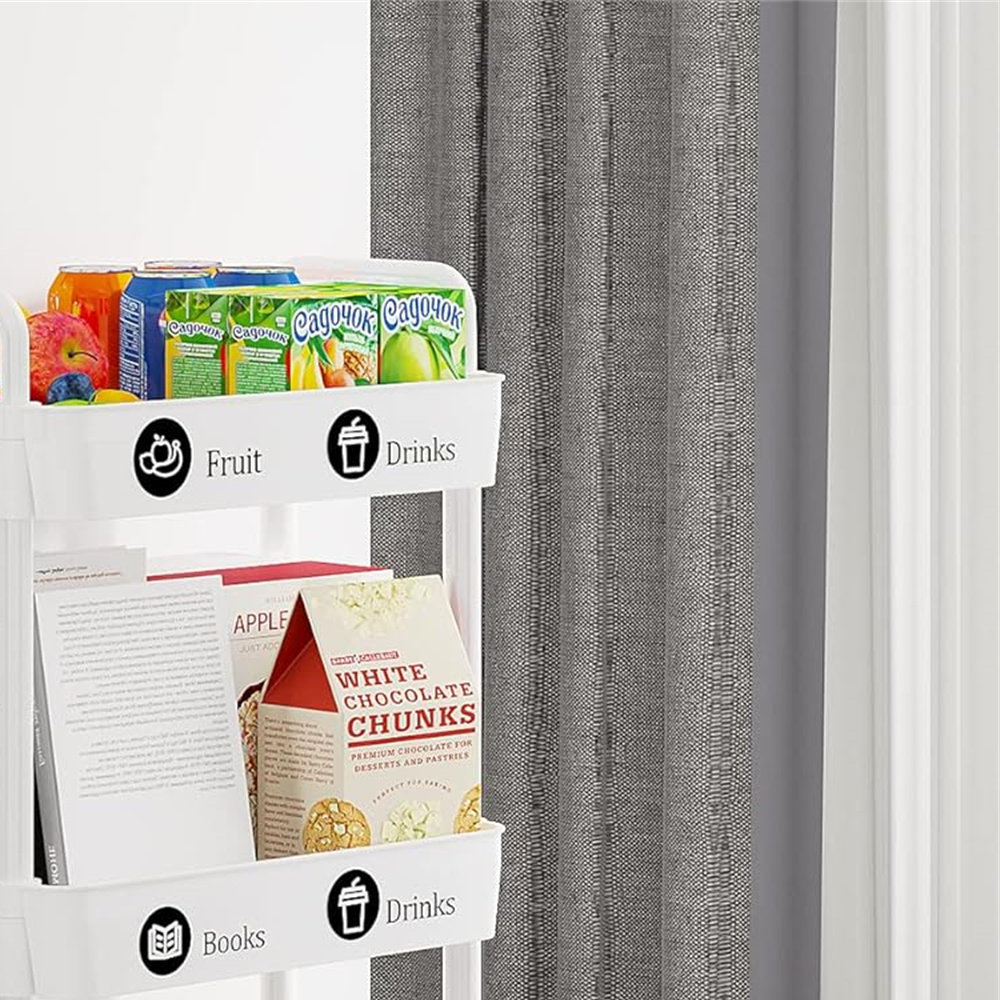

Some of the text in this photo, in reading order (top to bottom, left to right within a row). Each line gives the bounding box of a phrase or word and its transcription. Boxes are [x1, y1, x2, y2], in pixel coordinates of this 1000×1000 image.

[293, 303, 375, 342] Садочок
[384, 295, 464, 331] Садочок
[168, 321, 225, 340] Садочок
[232, 326, 290, 344] Садочок
[206, 448, 262, 478] Fruit
[386, 437, 456, 466] Drinks
[233, 610, 289, 634] APPLE
[335, 663, 427, 689] WHITE
[343, 682, 474, 710] CHOCOLATE
[347, 703, 476, 738] CHUNKS
[351, 739, 473, 761] PREMIUM CHOCOLATE FOR
[354, 752, 470, 773] DESSERTS AND PASTRIES
[385, 892, 456, 924] Drinks
[202, 926, 266, 956] Books
